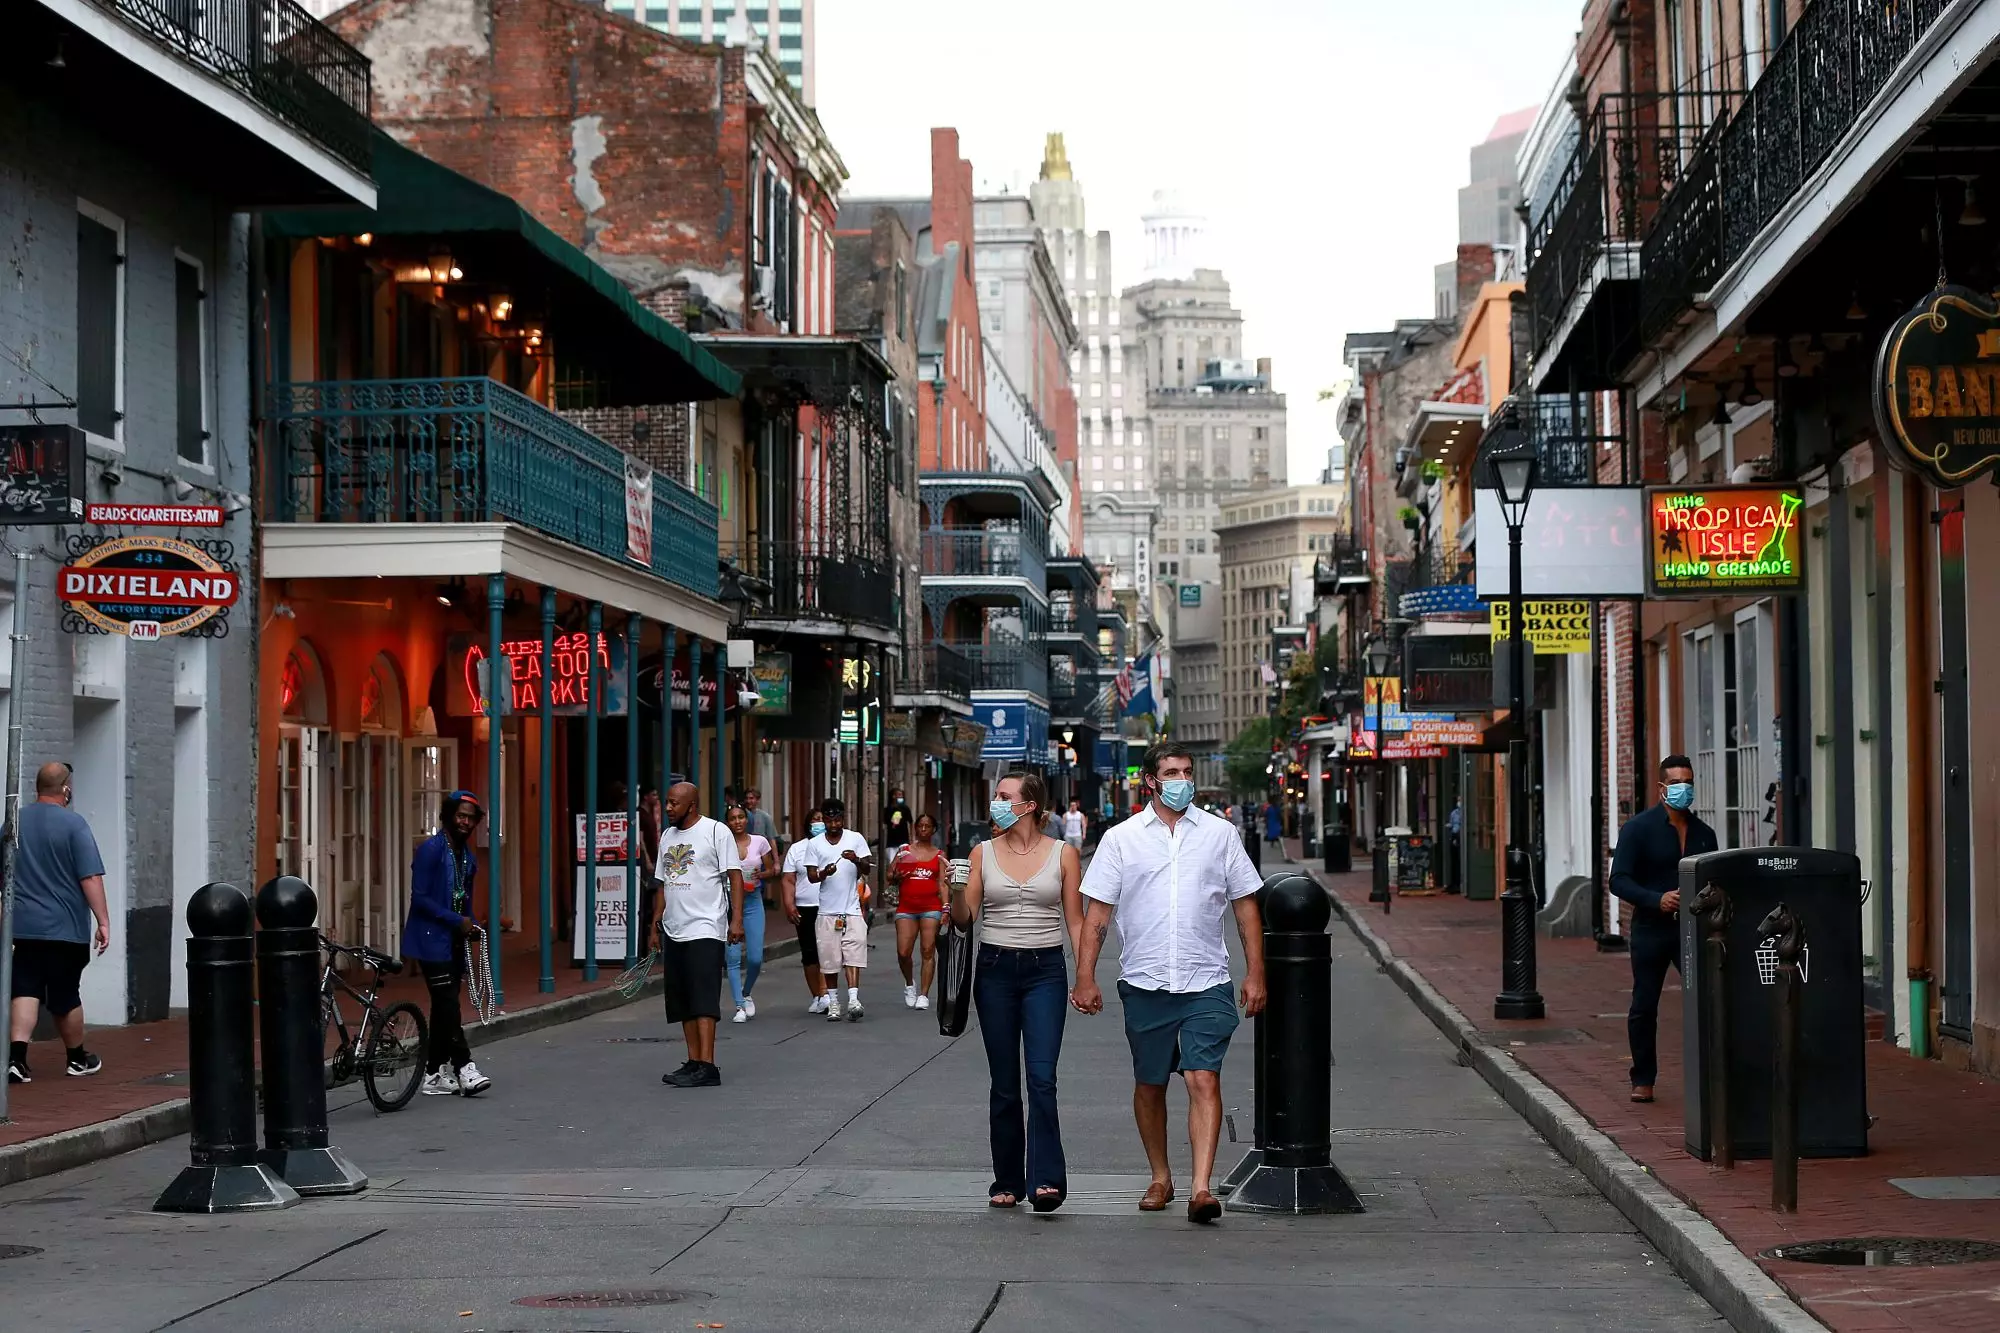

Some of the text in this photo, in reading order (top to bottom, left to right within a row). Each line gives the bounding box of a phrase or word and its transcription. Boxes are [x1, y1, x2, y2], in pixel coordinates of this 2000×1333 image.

[1953, 428, 2000, 445] NEW ORL
[1666, 496, 1705, 508] Little
[1658, 505, 1794, 531] TROPICAL
[1701, 532, 1757, 555] ISLE
[86, 542, 126, 563] CLOTHING
[129, 539, 159, 547] MASKS
[133, 552, 164, 564] 434
[1664, 560, 1792, 577] HAND GRENADE
[66, 573, 232, 600] DIXIELAND
[99, 603, 191, 616] FACTORY OUTLET
[1494, 603, 1589, 616] BURBO
[1498, 617, 1590, 630] TBACC
[131, 624, 159, 637] ATM
[654, 669, 717, 691] Boubon
[1365, 679, 1400, 704] MA
[1413, 722, 1474, 732] COURTYARD
[1409, 733, 1477, 744] LIVE MUSIC
[1419, 748, 1442, 757] BAR
[1758, 858, 1799, 867] BigBelly
[597, 913, 628, 926] PEN
